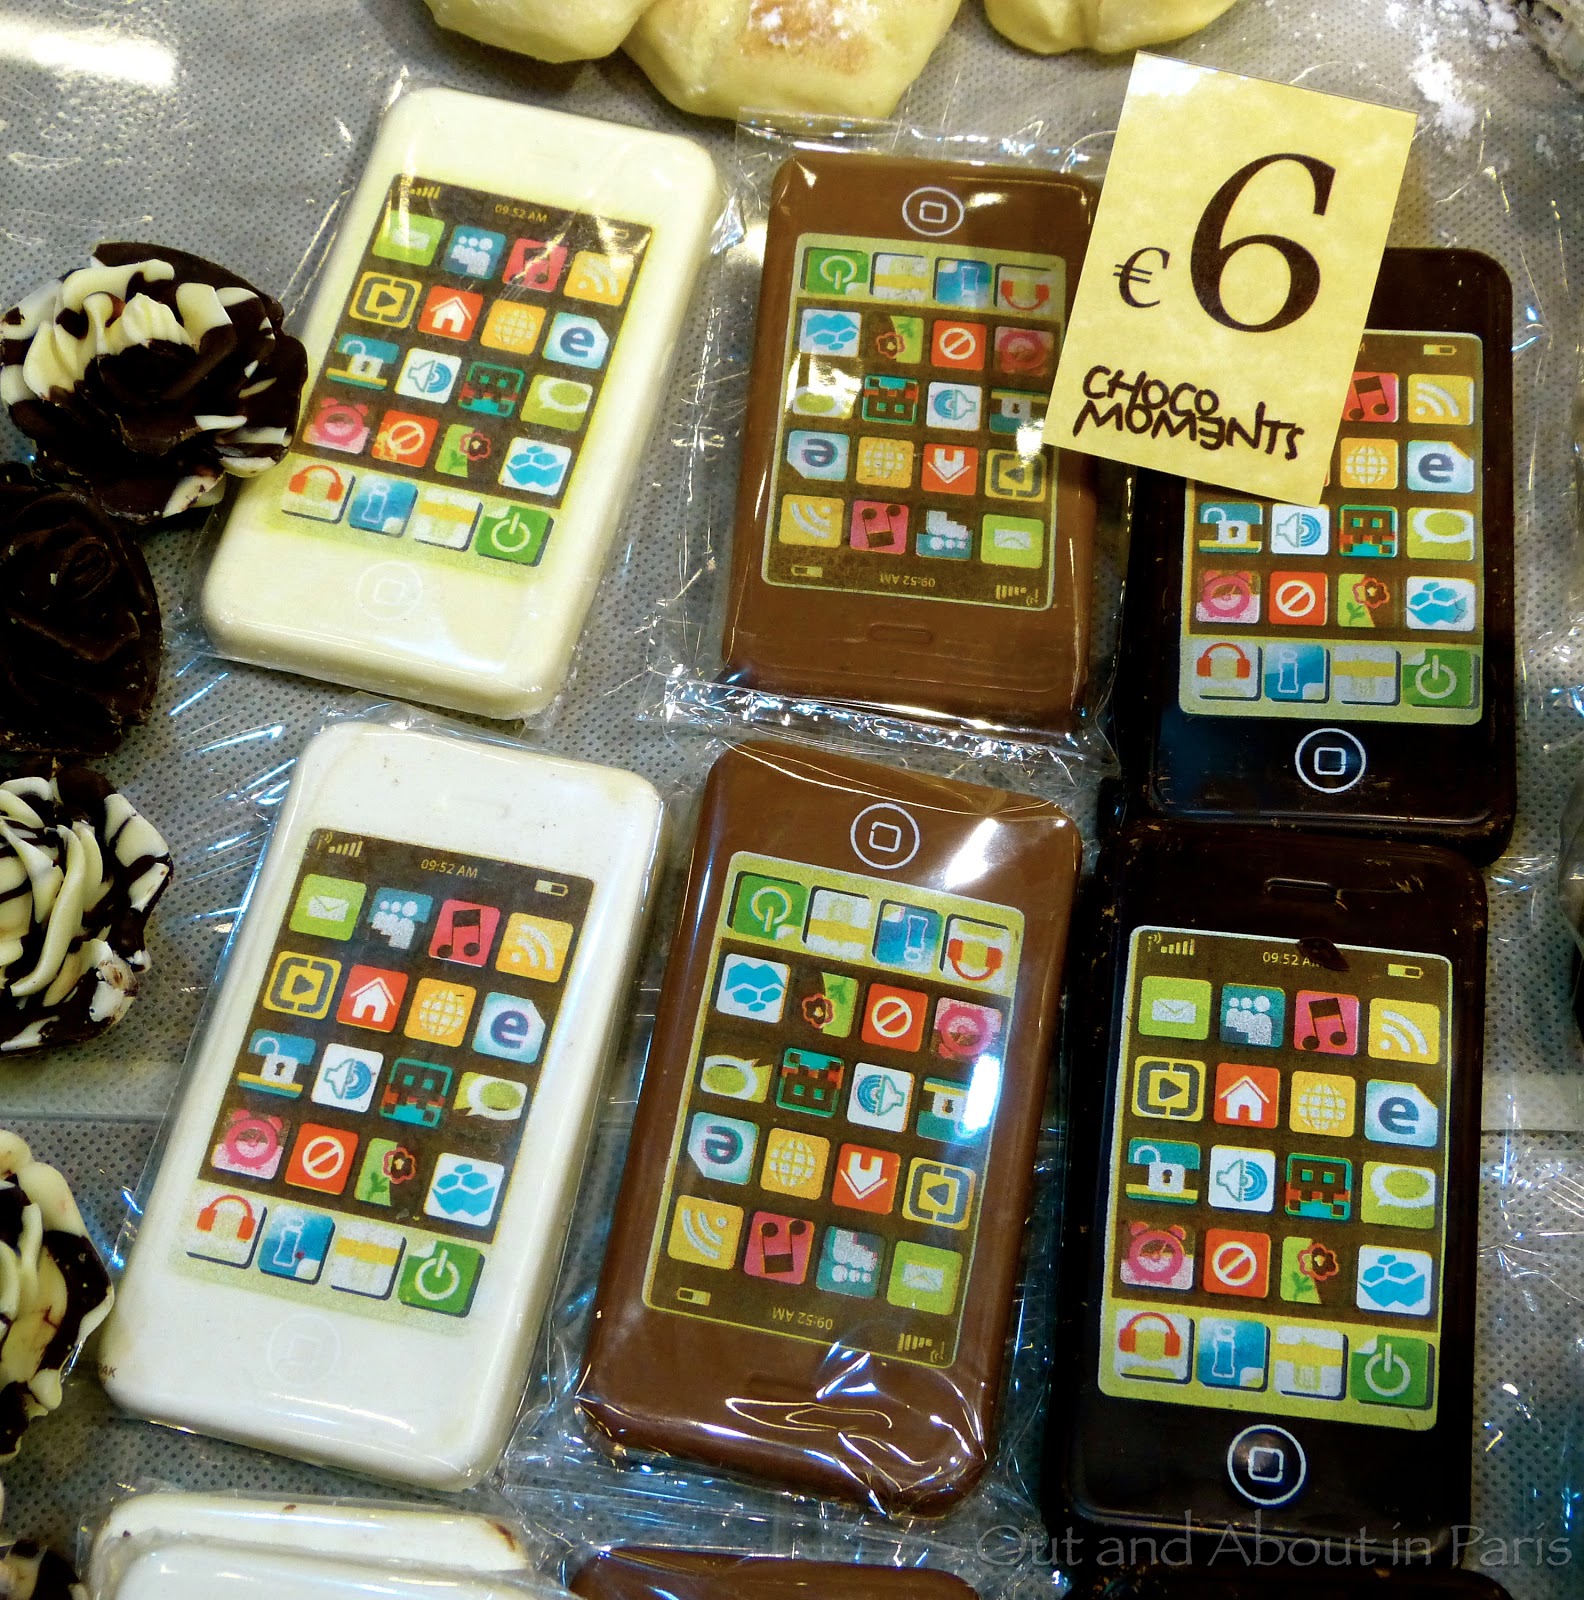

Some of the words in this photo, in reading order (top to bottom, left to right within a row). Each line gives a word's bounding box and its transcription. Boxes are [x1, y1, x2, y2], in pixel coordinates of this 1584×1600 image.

[527, 211, 548, 223] AM
[1112, 246, 1171, 309] €
[1190, 152, 1336, 333] 6
[1082, 364, 1220, 417] CHOCO
[1072, 398, 1305, 462] MOMENTS
[879, 572, 900, 585] AM
[420, 858, 456, 875] 09:52
[455, 864, 479, 879] AM
[772, 1306, 795, 1323] AM
[797, 1311, 834, 1331] 09:52
